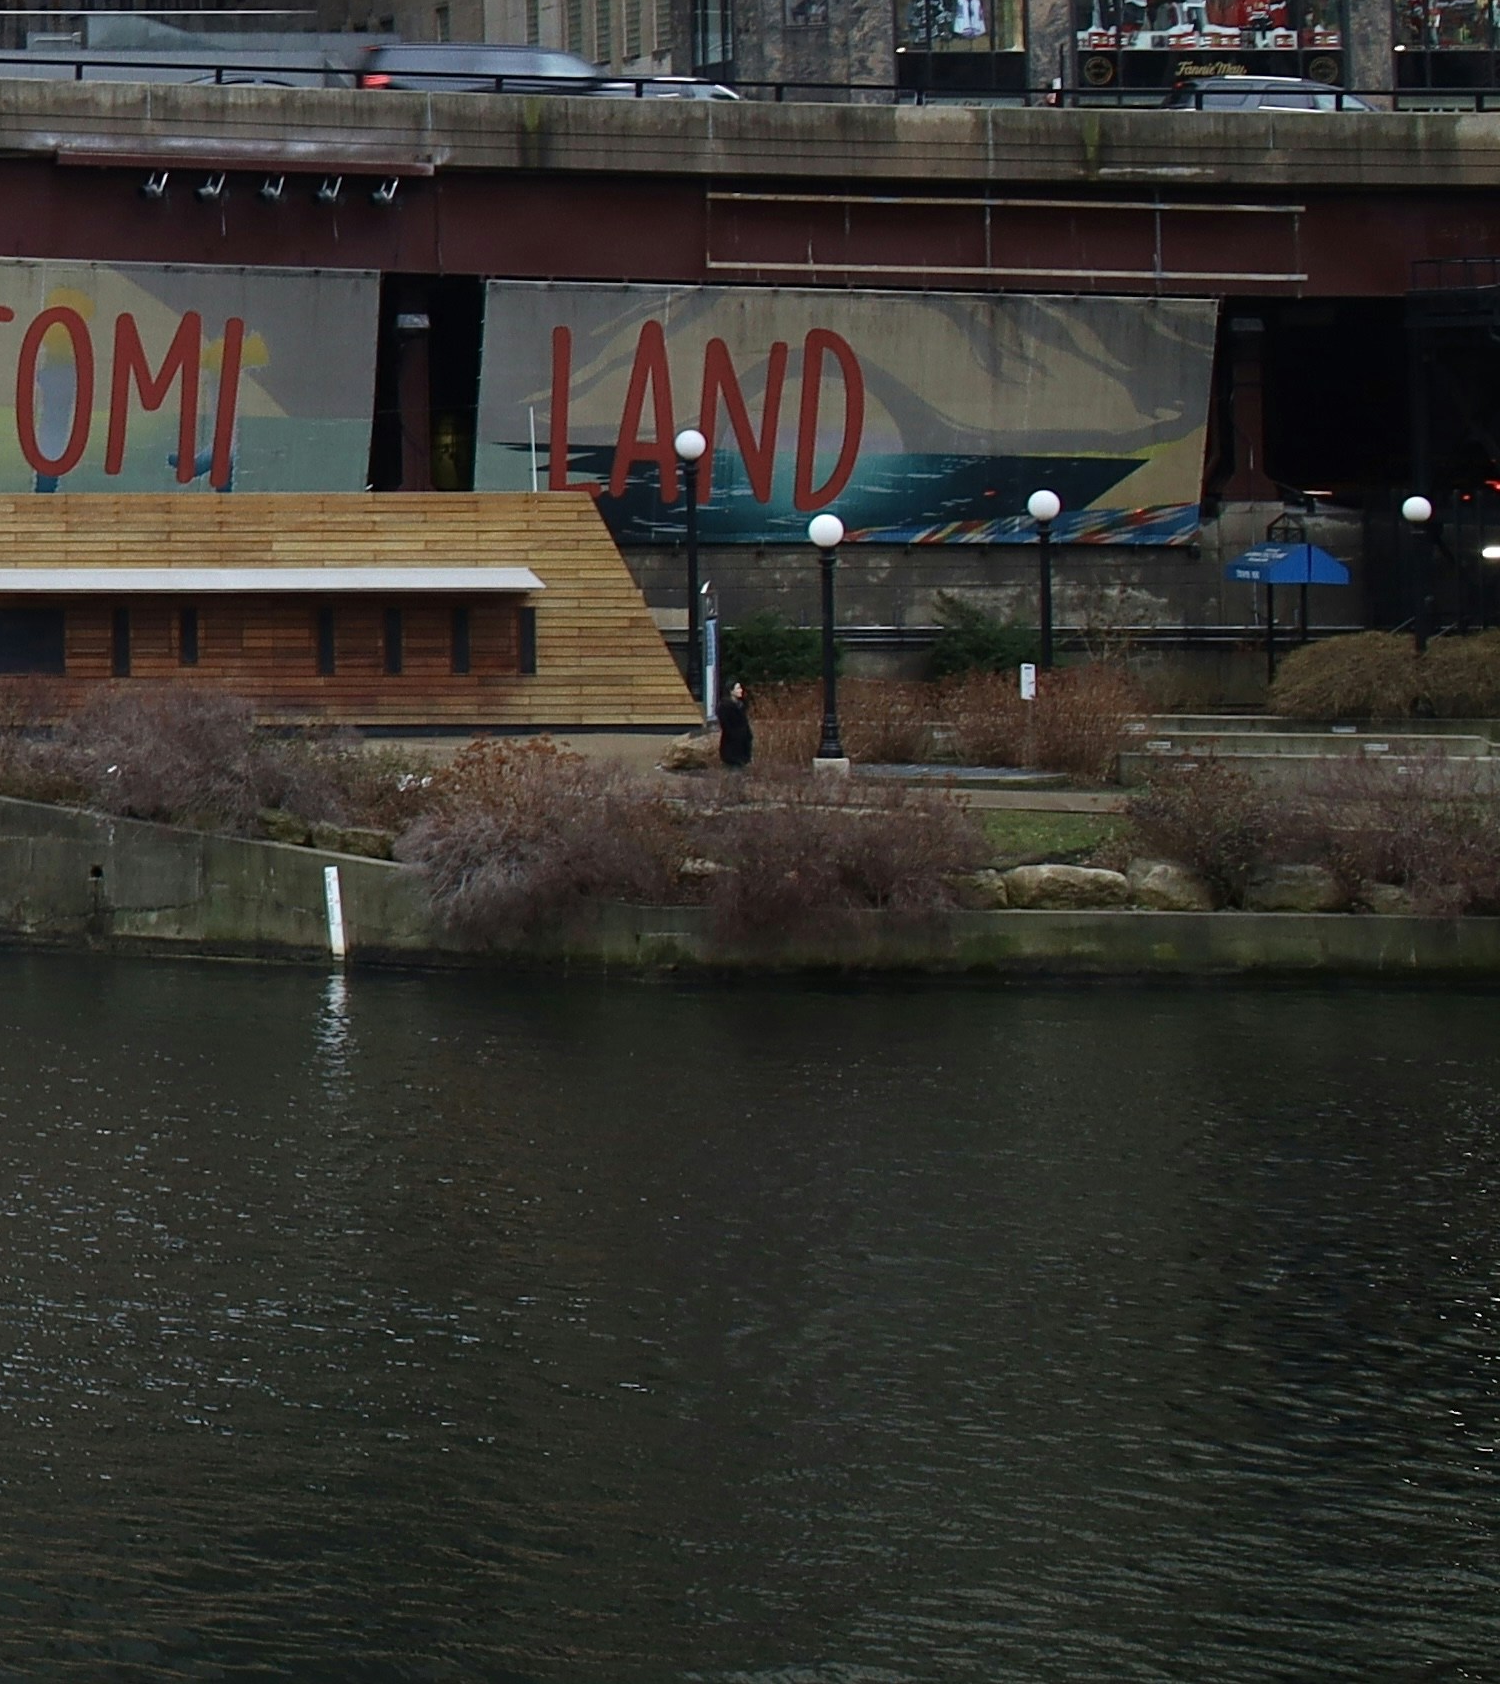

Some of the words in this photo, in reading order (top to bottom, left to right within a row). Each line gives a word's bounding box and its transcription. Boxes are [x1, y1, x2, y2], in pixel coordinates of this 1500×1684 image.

[1175, 61, 1216, 76] Fannie
[1215, 61, 1246, 76] May
[549, 319, 866, 513] LAND
